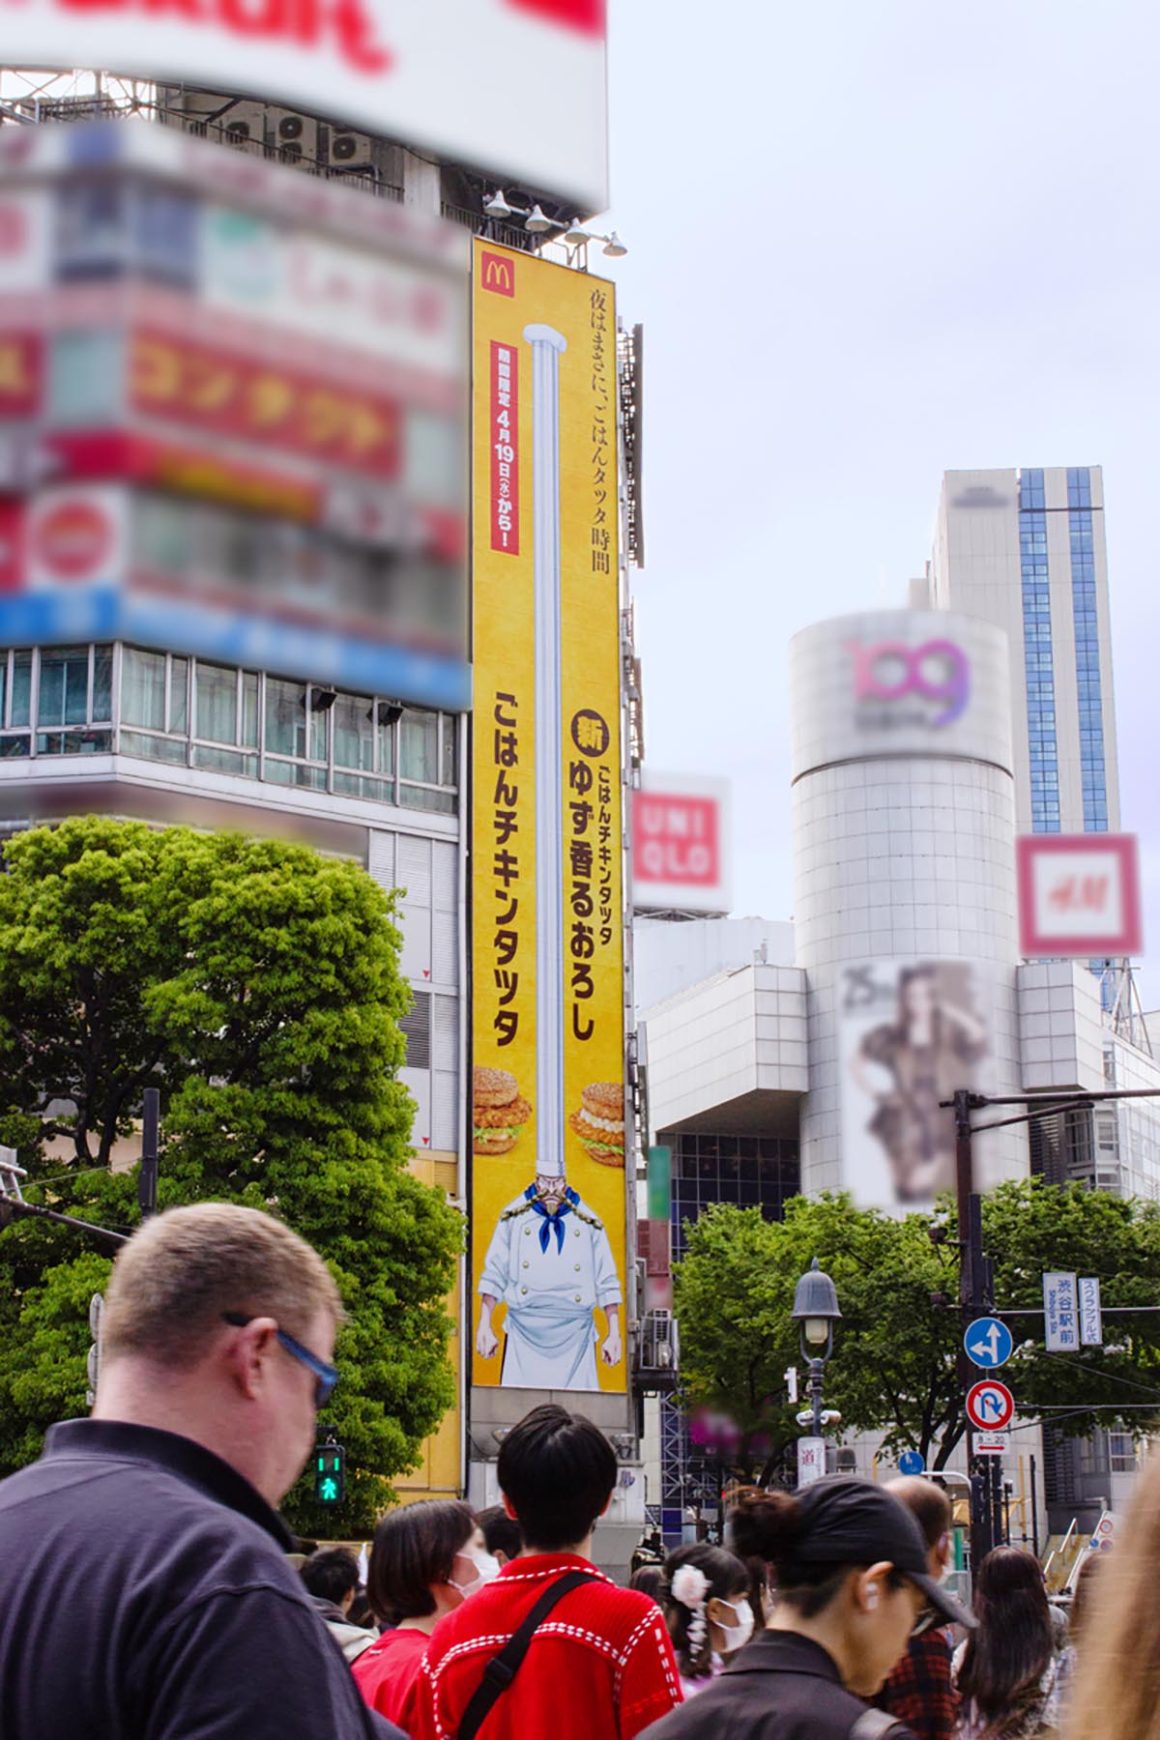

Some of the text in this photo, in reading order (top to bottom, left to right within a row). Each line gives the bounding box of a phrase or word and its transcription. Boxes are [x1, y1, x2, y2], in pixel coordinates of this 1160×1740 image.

[493, 691, 518, 1046] ごはんチキンタツタ
[569, 761, 594, 1041] ゆず香るおろし
[1058, 1280, 1074, 1343] 渋谷駅前
